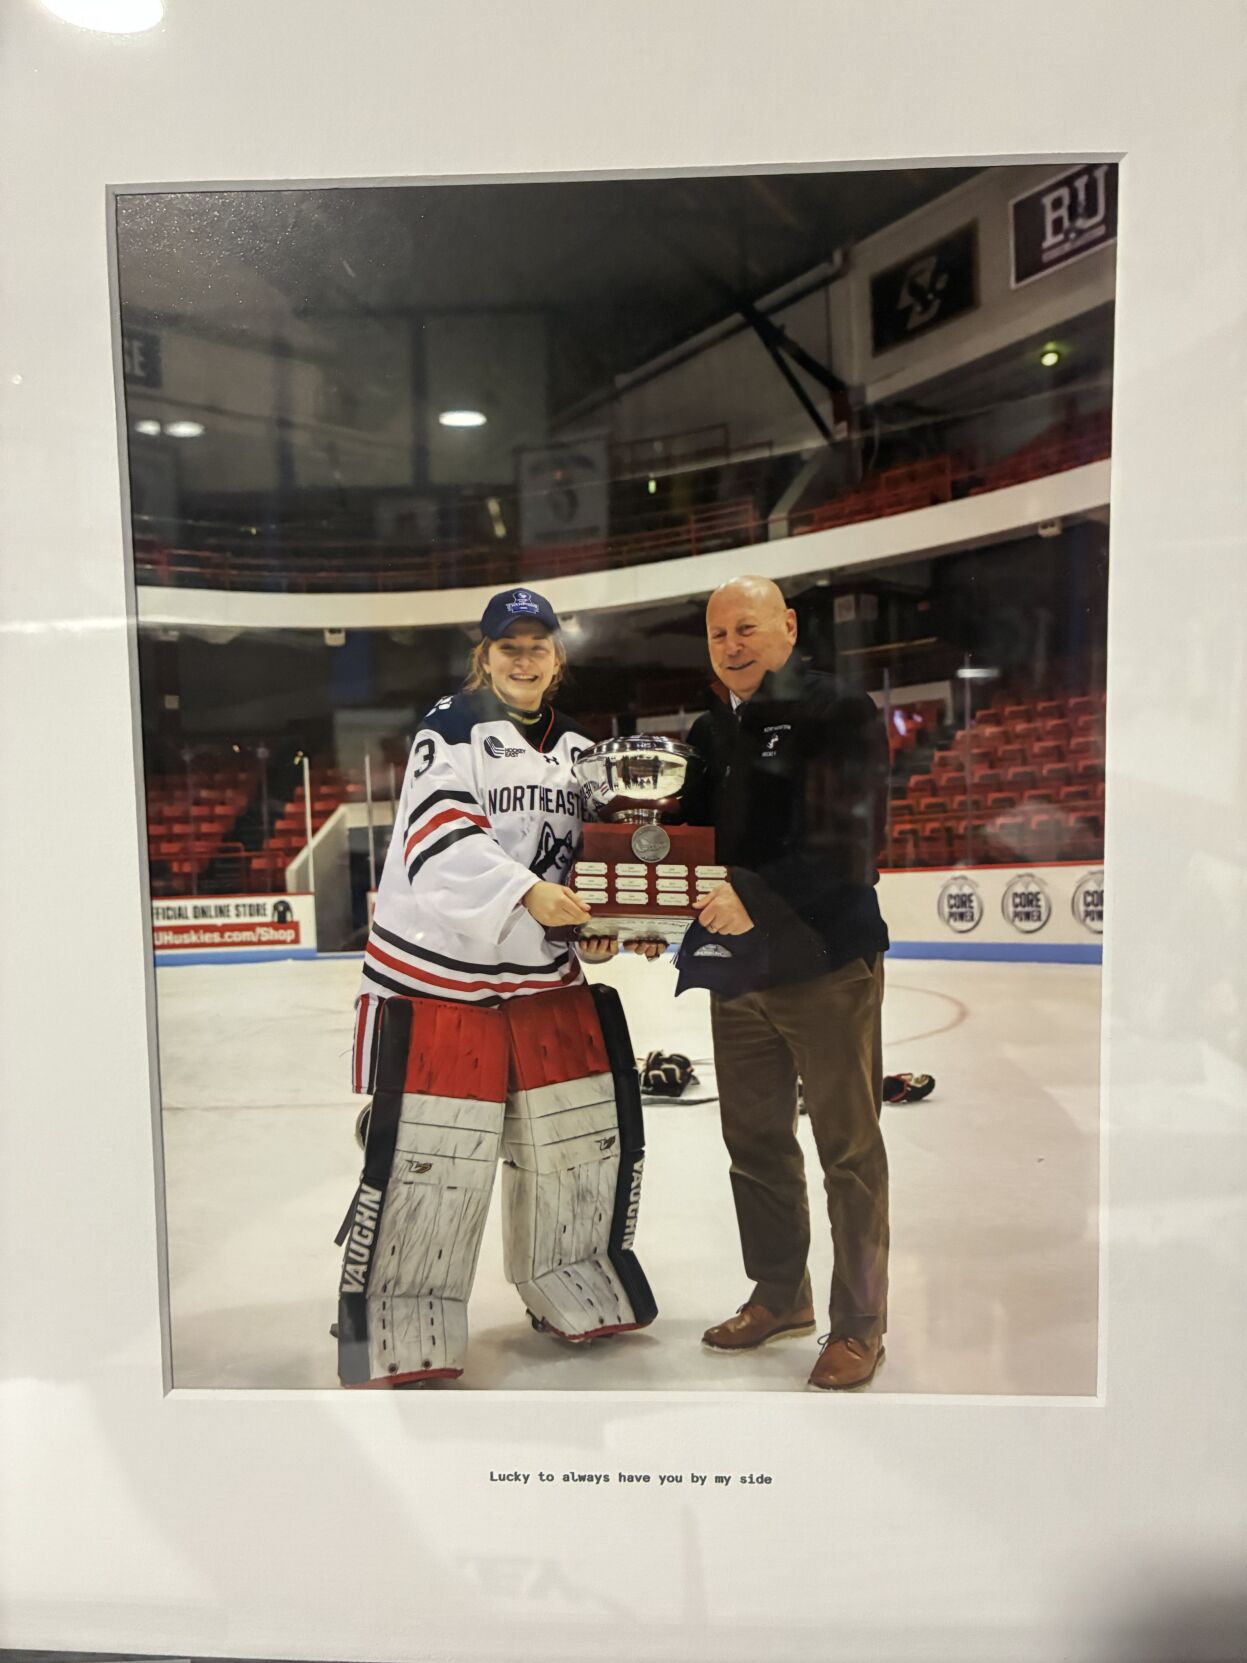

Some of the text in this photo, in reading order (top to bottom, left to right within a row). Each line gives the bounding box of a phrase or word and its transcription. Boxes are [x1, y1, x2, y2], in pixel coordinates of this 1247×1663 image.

[1042, 164, 1109, 249] BU
[414, 738, 436, 778] 3
[947, 893, 975, 909] CORE
[1012, 891, 1042, 909] CORE
[192, 904, 231, 919] ONLINE
[234, 902, 268, 918] STORE
[947, 910, 975, 922] POWER
[1012, 909, 1042, 922] POWER
[621, 1157, 645, 1250] VAUGHN
[341, 1183, 383, 1293] VAUGHN
[489, 1471, 773, 1487] Lucky to always have you by my side
